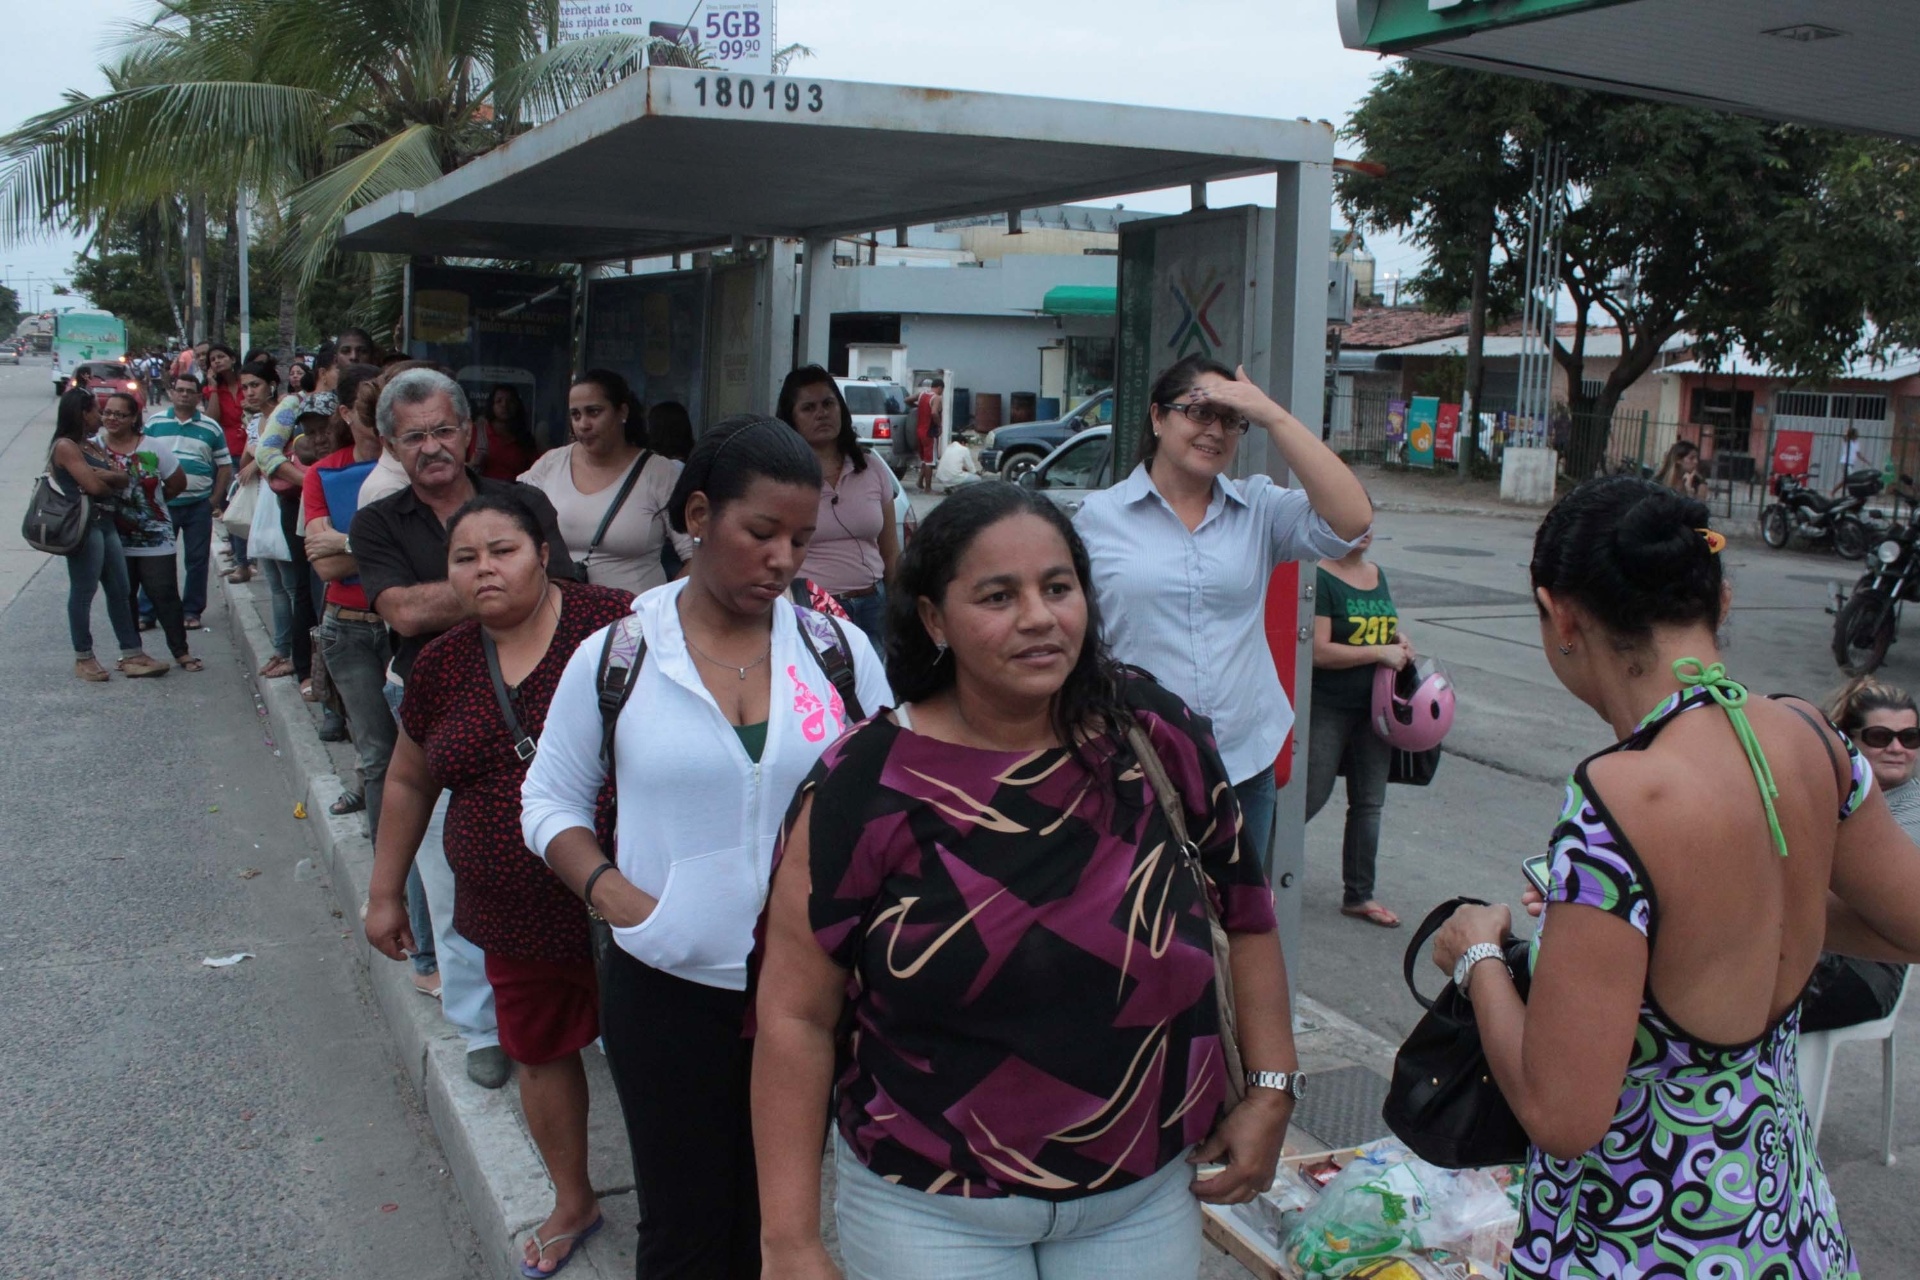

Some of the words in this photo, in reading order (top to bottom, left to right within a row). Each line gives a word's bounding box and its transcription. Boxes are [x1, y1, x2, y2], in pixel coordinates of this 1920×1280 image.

[560, 5, 591, 16] ternet
[595, 3, 610, 14] até
[615, 3, 633, 13] 10x
[559, 18, 574, 28] ais
[577, 15, 609, 30] rápida
[621, 17, 642, 26] com
[706, 11, 760, 38] 5GB
[694, 76, 824, 113] 180193
